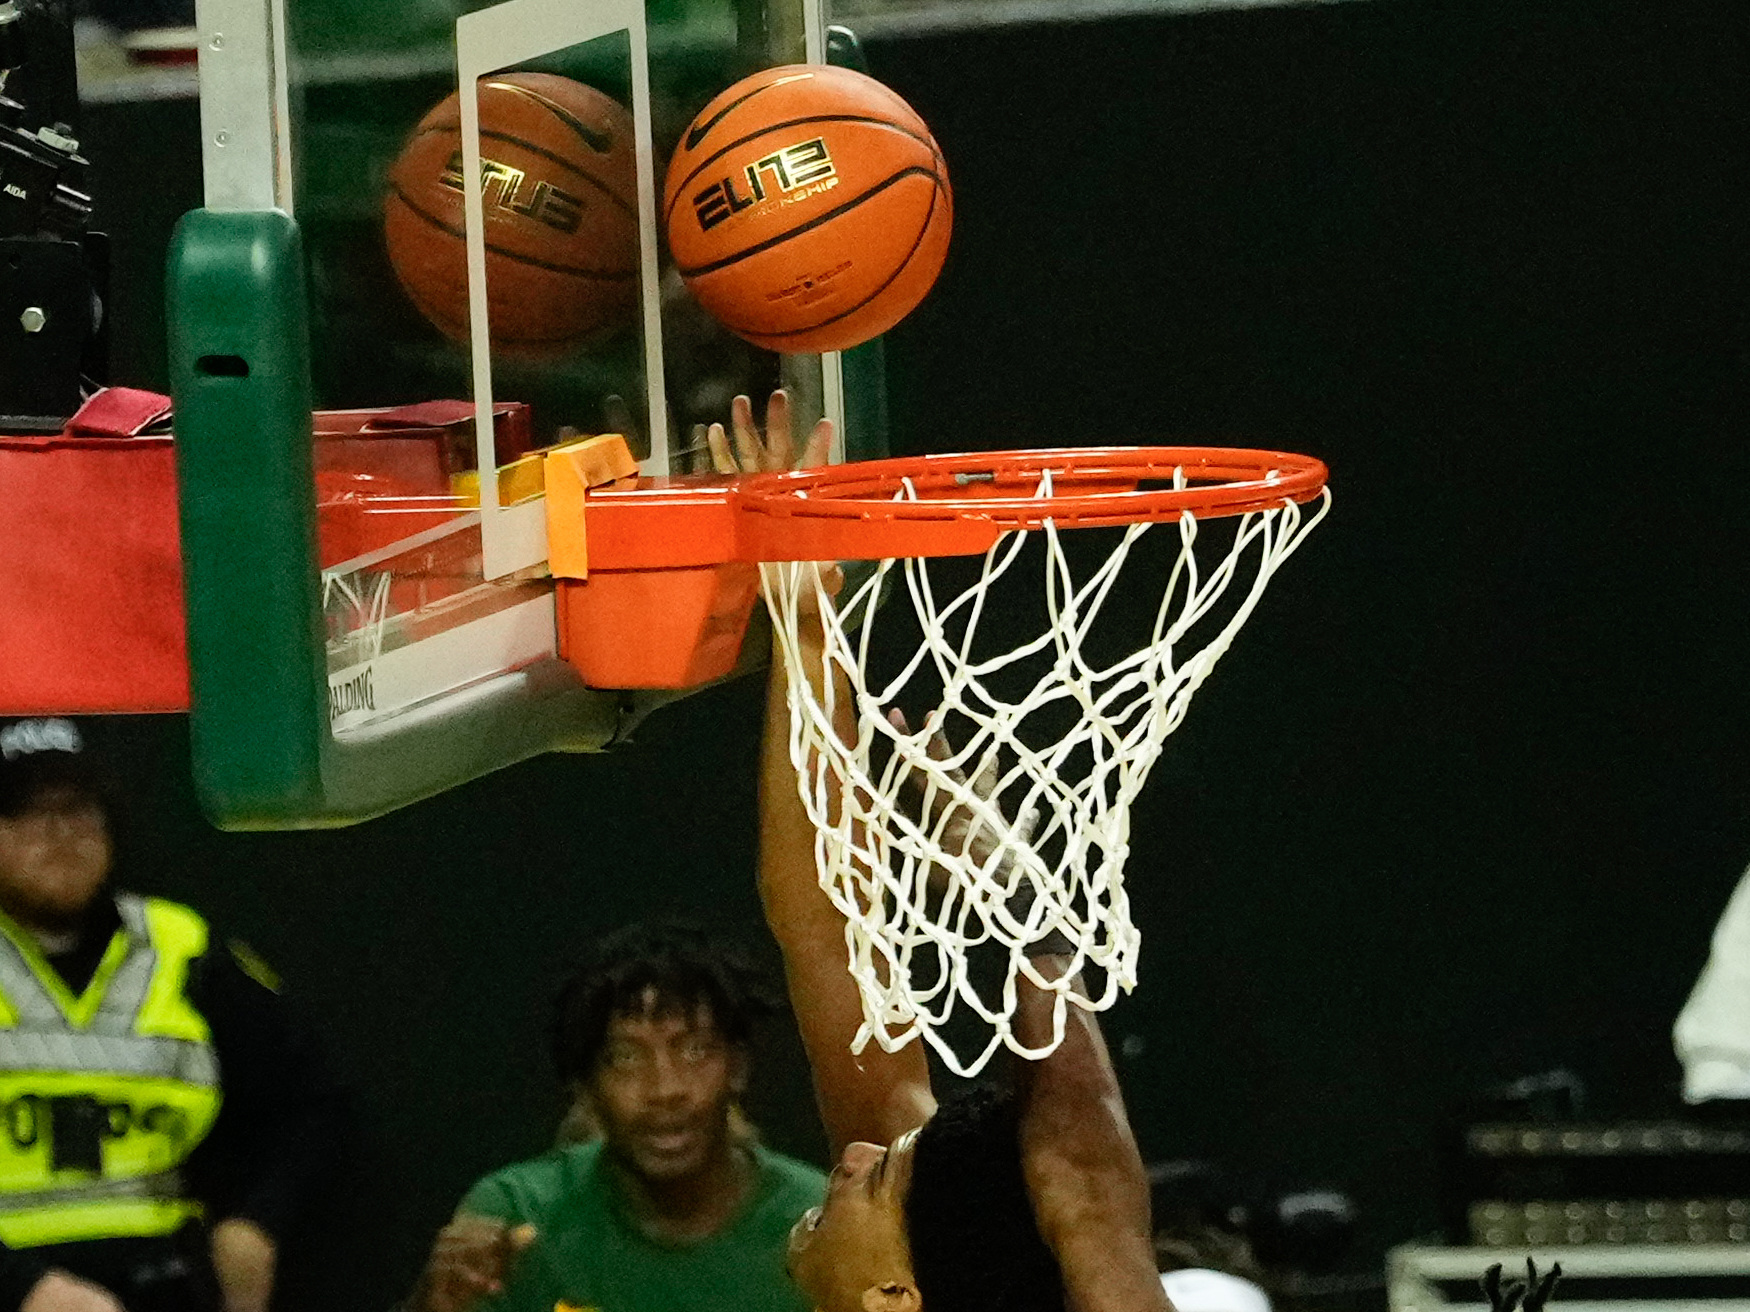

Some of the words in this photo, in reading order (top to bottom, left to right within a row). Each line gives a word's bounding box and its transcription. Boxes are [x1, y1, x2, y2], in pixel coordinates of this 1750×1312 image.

[2, 183, 27, 200] AIDA
[693, 136, 836, 232] ELITE
[327, 664, 376, 720] PALDING
